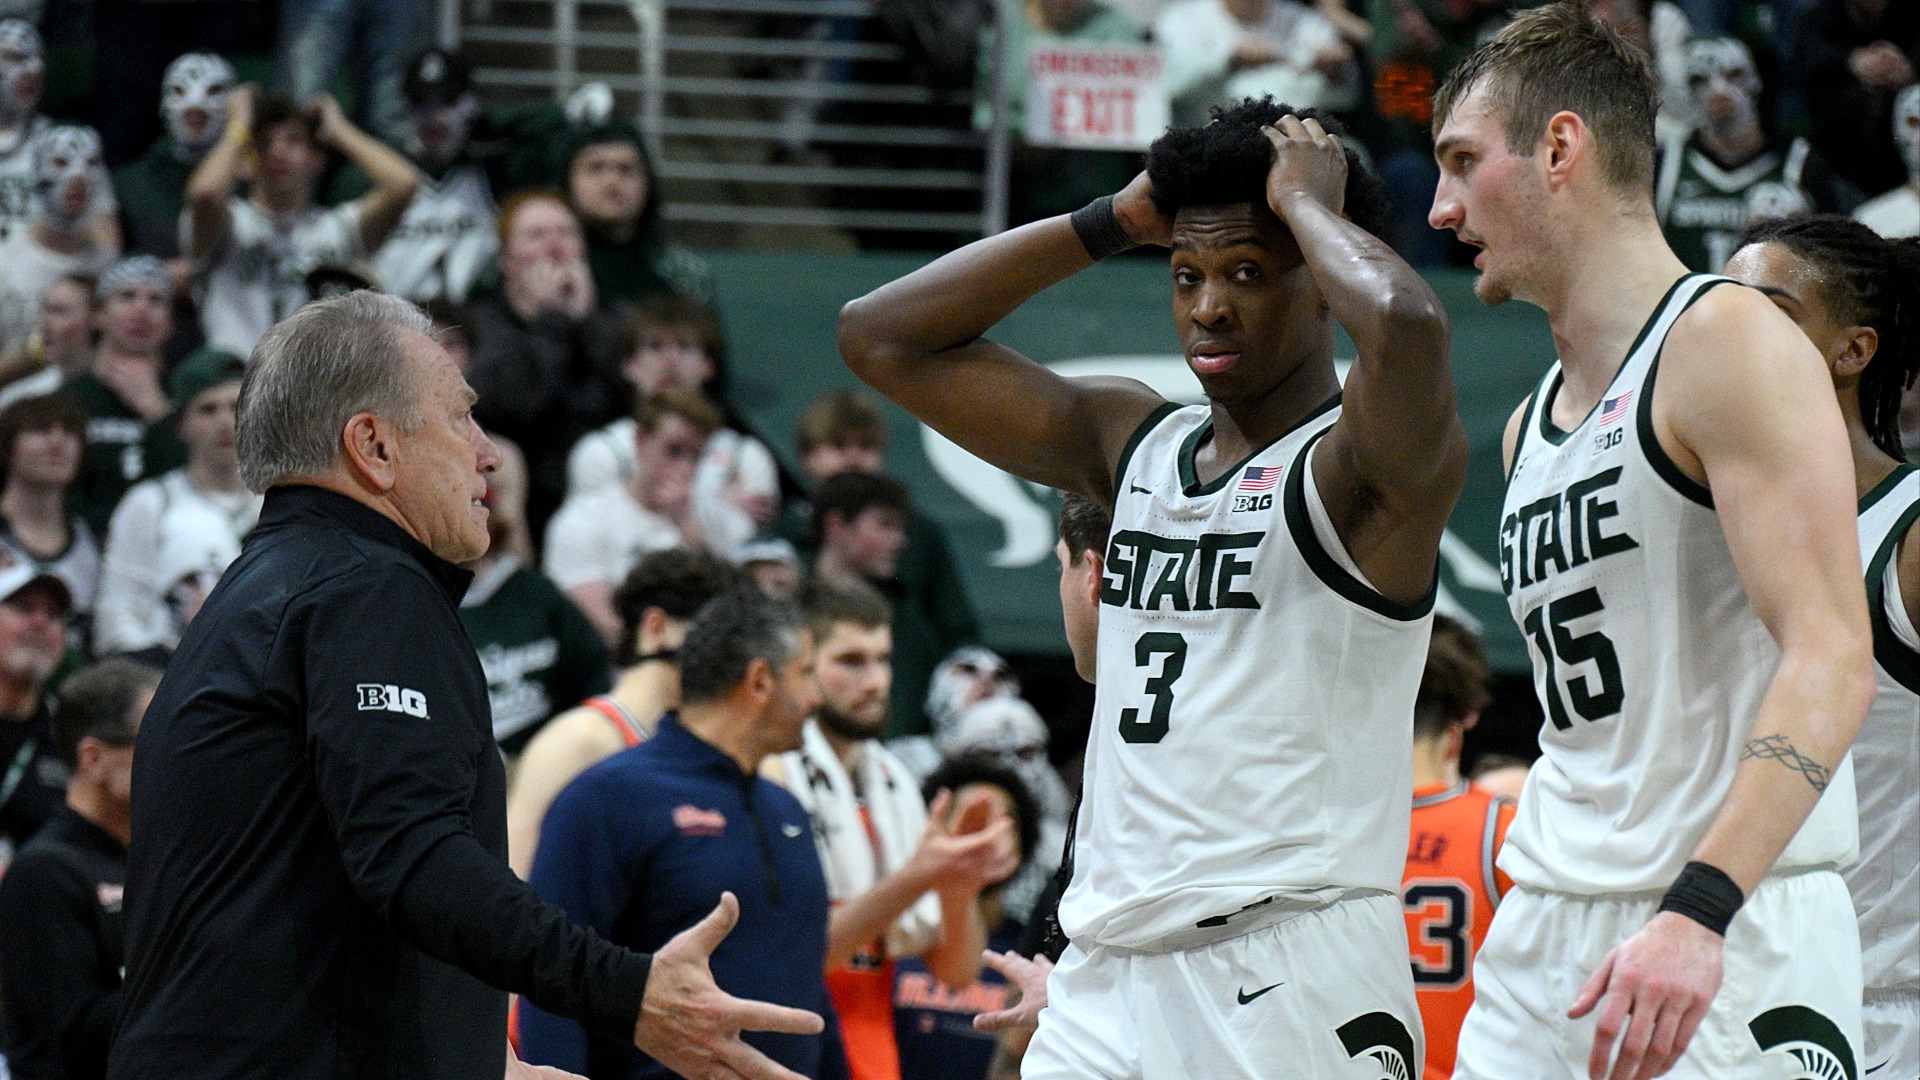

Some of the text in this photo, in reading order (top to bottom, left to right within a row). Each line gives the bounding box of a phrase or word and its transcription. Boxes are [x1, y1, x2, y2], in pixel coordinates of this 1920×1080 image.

[1053, 85, 1137, 135] EXIT
[1100, 529, 1267, 612] STATE
[1500, 465, 1640, 598] STATE
[1117, 631, 1188, 744] 3
[1524, 586, 1625, 731] 15
